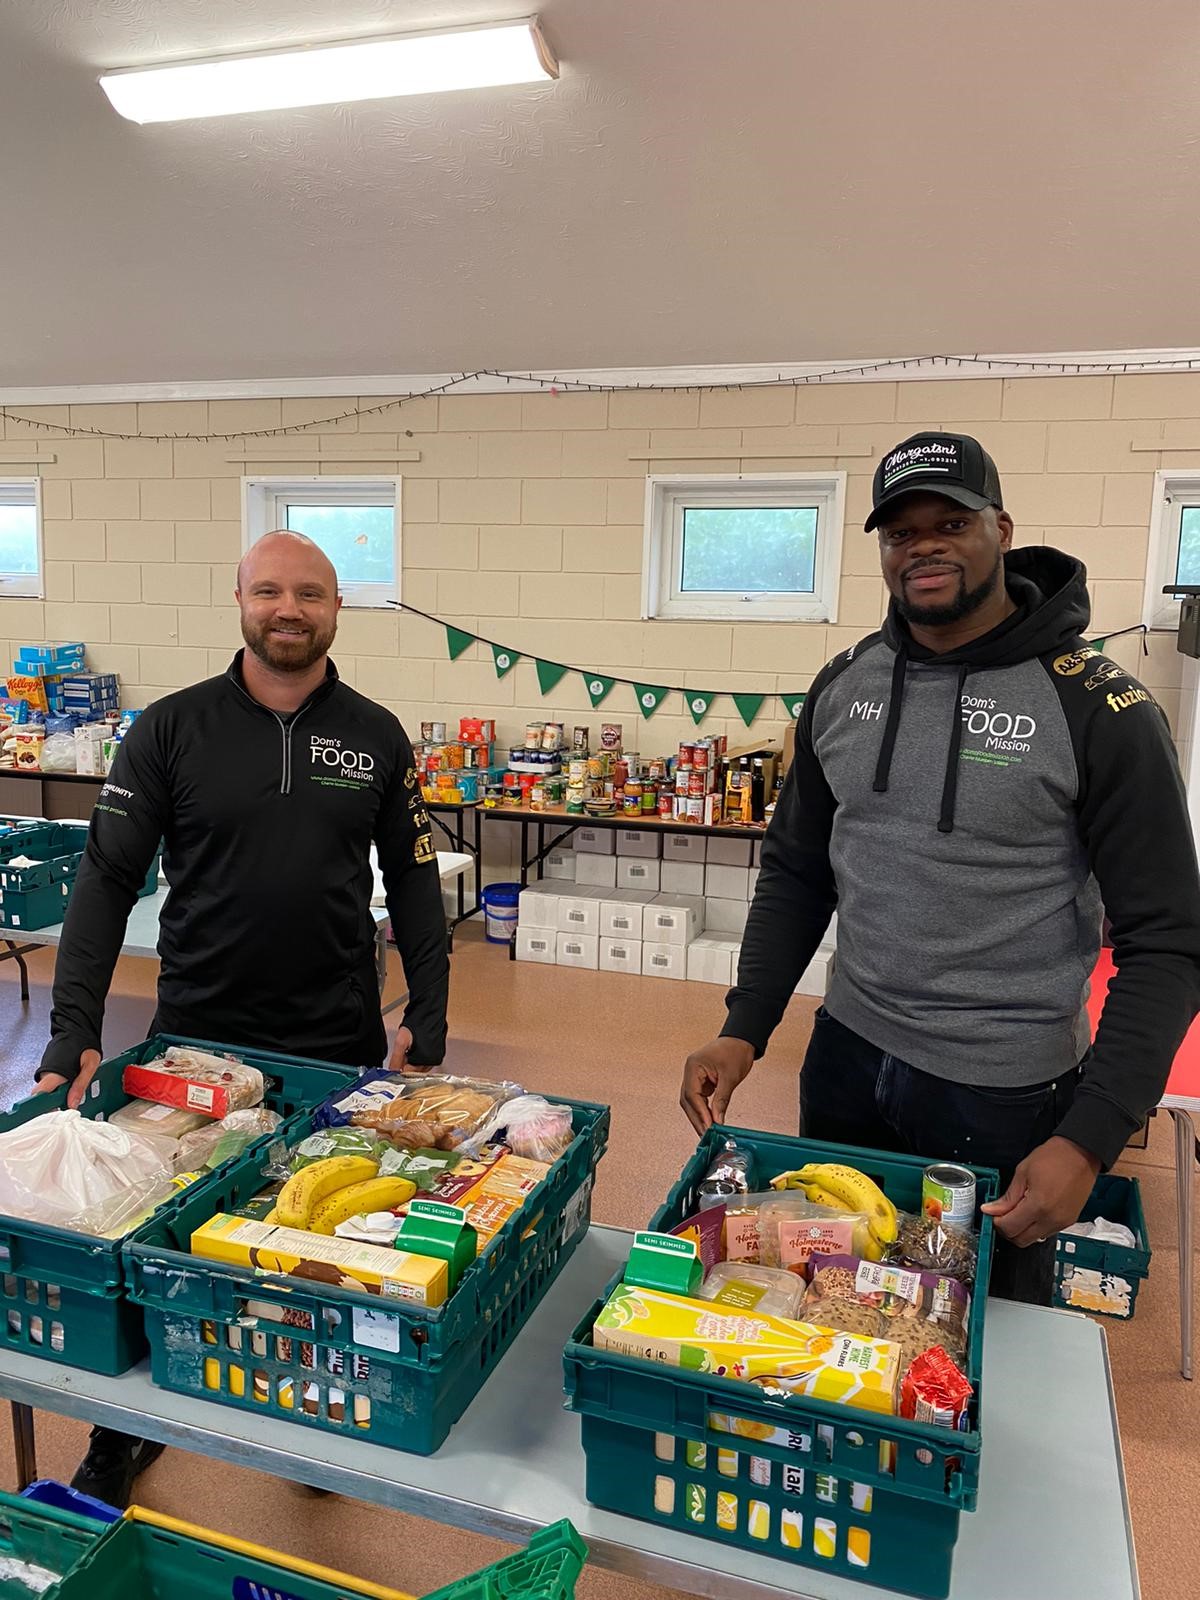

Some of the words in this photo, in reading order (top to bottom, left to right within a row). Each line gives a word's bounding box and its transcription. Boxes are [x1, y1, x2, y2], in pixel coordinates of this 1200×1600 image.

[961, 695, 997, 709] Dom's
[1106, 684, 1149, 713] fuzio
[849, 701, 884, 721] MH
[310, 735, 342, 748] Dom's
[985, 736, 1031, 752] Mission
[309, 746, 375, 771] FOOD
[340, 767, 374, 782] Mission
[418, 1205, 430, 1213] SEMI
[431, 1208, 457, 1217] SKIMMED
[643, 1237, 658, 1245] SEMI
[659, 1241, 687, 1250] SKIMMED
[746, 1241, 759, 1251] FA
